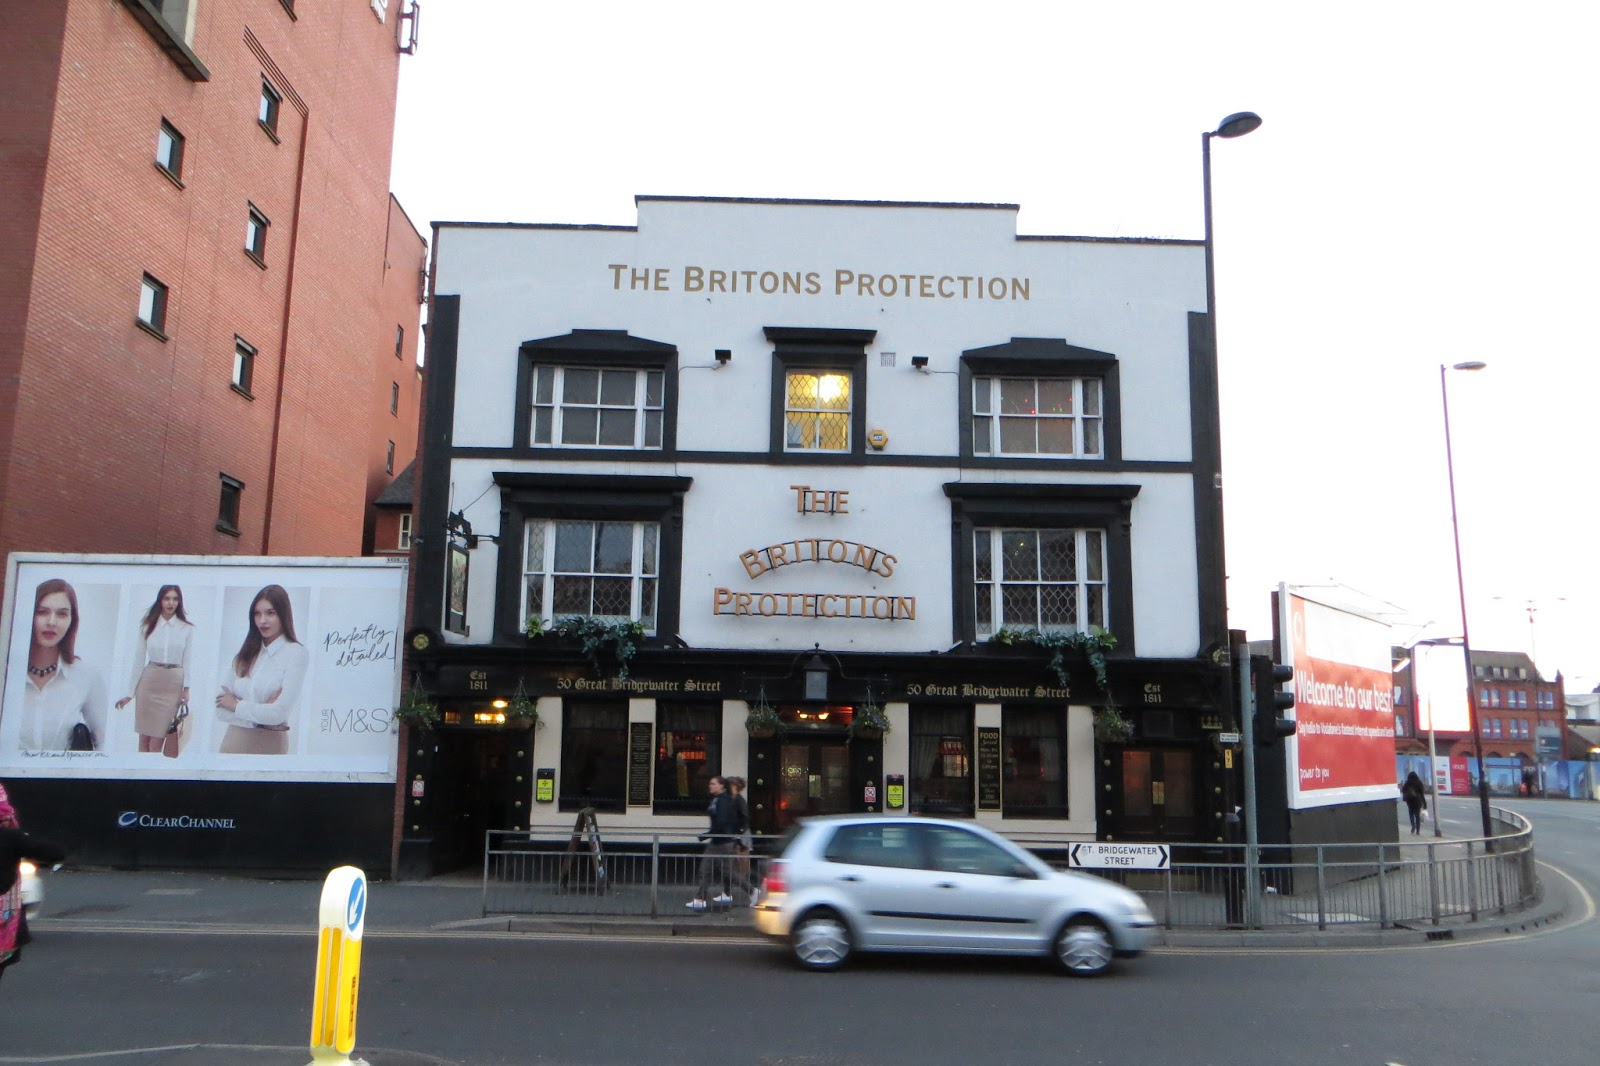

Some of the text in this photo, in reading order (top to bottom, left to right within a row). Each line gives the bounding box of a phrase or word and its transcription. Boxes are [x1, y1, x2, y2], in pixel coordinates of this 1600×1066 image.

[608, 264, 1030, 300] THE BRITONS PROTECTION
[790, 485, 849, 513] THE
[739, 538, 898, 580] BRITONS
[713, 587, 916, 620] PROTECTION
[336, 643, 395, 666] detailed
[470, 681, 488, 690] 1811
[557, 677, 721, 692] 50 Great Bridgewater Street
[907, 683, 1071, 699] 50 Great Bridgewater Street
[1297, 670, 1392, 713] Welcome to our best
[1144, 693, 1162, 703] 1811
[329, 708, 389, 733] M&S
[1300, 765, 1330, 783] power to you
[1098, 846, 1158, 855] BRIDGEWATER
[1105, 857, 1135, 865] STREET
